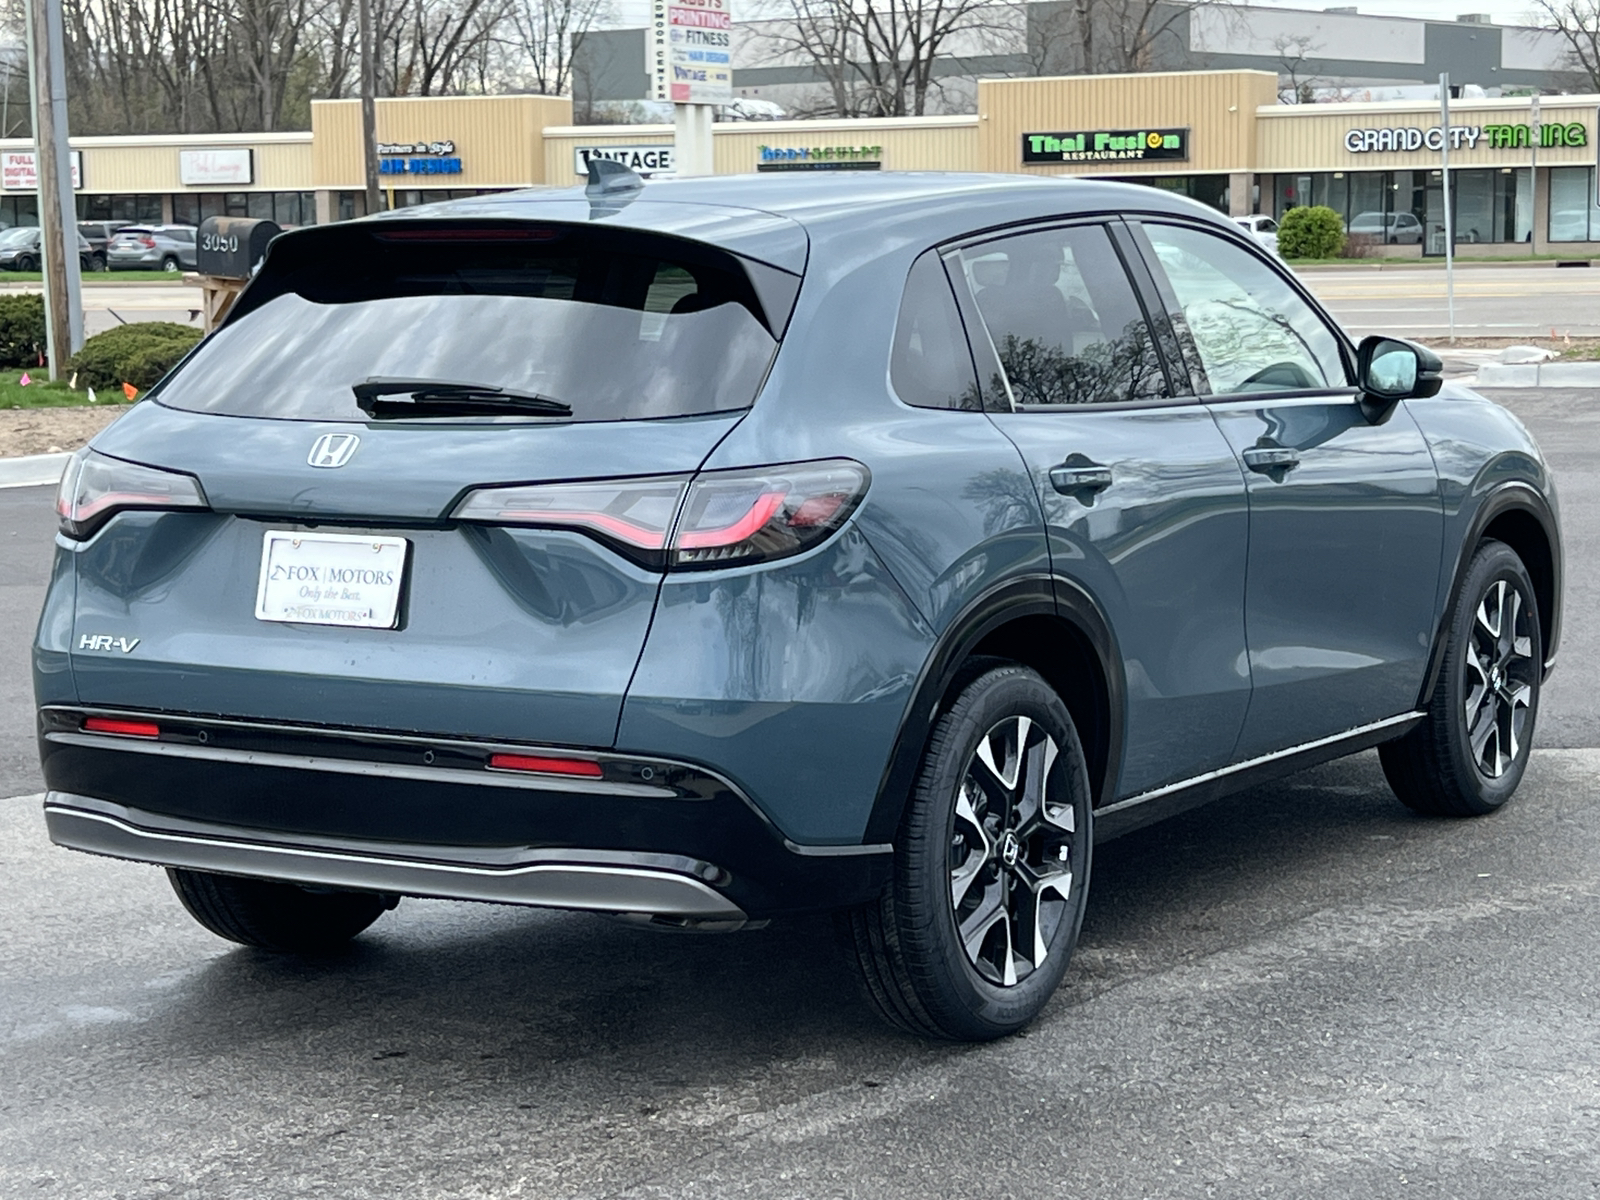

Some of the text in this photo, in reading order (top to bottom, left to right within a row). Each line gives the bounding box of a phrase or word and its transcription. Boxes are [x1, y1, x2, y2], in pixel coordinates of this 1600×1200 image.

[670, 9, 730, 29] PRINTING
[686, 30, 729, 47] FITNESS
[1028, 132, 1180, 153] Thai Fusion
[1344, 122, 1587, 152] GRAND CTY TANING
[579, 149, 670, 172] VNTAGE
[1062, 150, 1144, 161] RESTAURANT
[202, 233, 239, 253] 3050
[287, 566, 393, 586] FOX MOTORS
[299, 585, 321, 602] Only
[323, 586, 339, 600] the
[319, 609, 362, 622] MOTORS
[79, 634, 140, 653] HR-V
